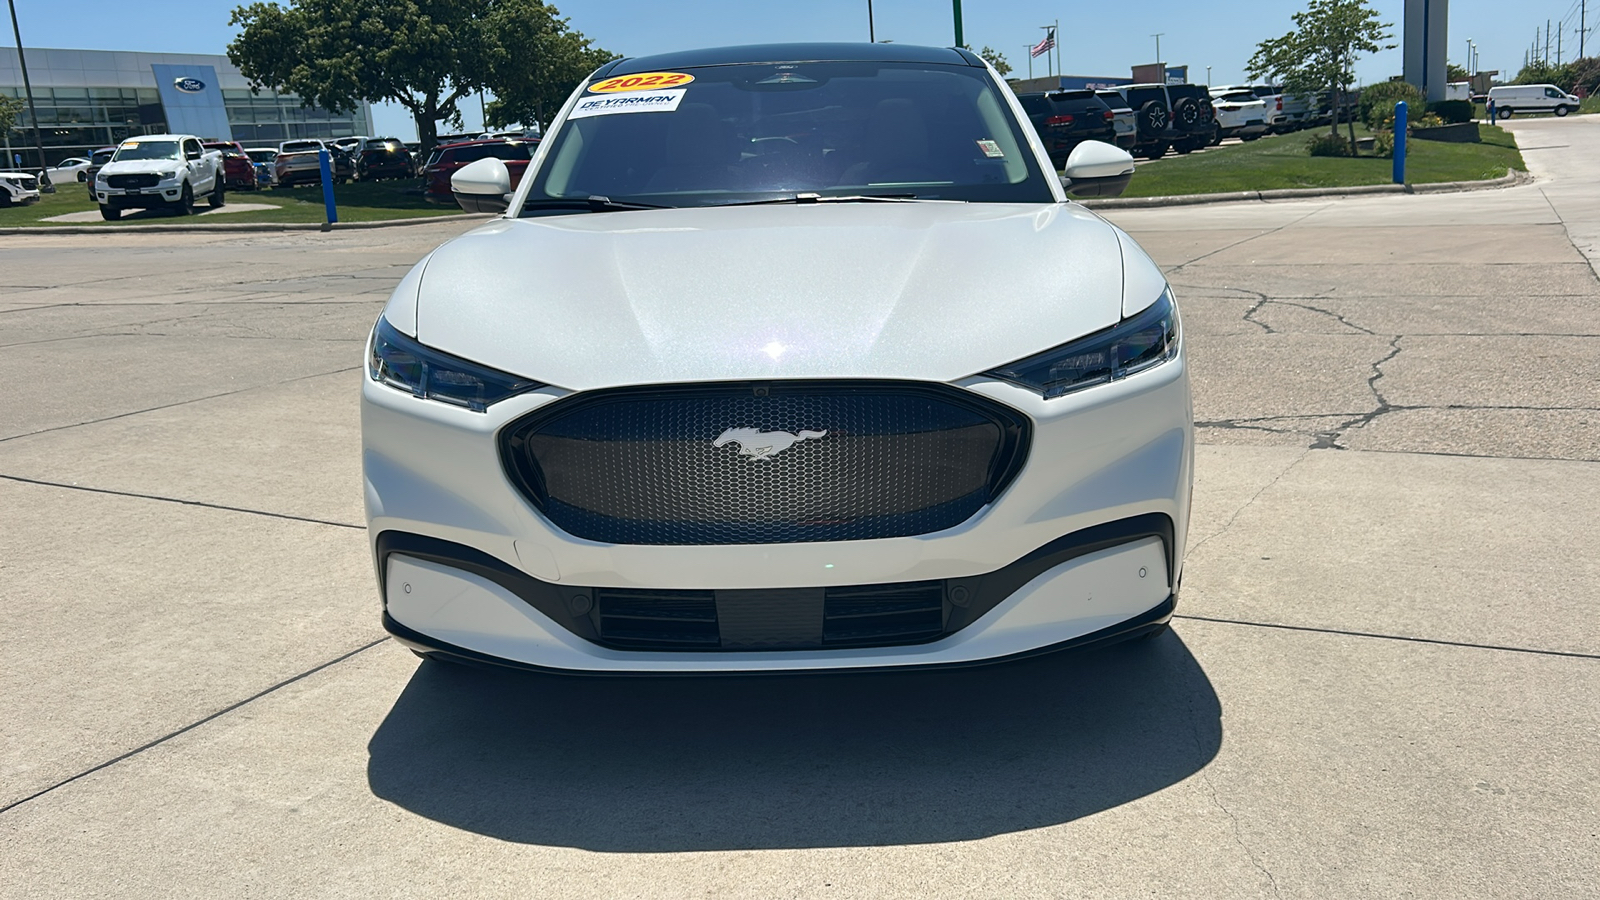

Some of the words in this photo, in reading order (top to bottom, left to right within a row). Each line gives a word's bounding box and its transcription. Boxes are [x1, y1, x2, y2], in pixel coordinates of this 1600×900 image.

[184, 80, 201, 90] Ford
[598, 75, 686, 91] 2022
[580, 95, 677, 109] DEYARMAN
